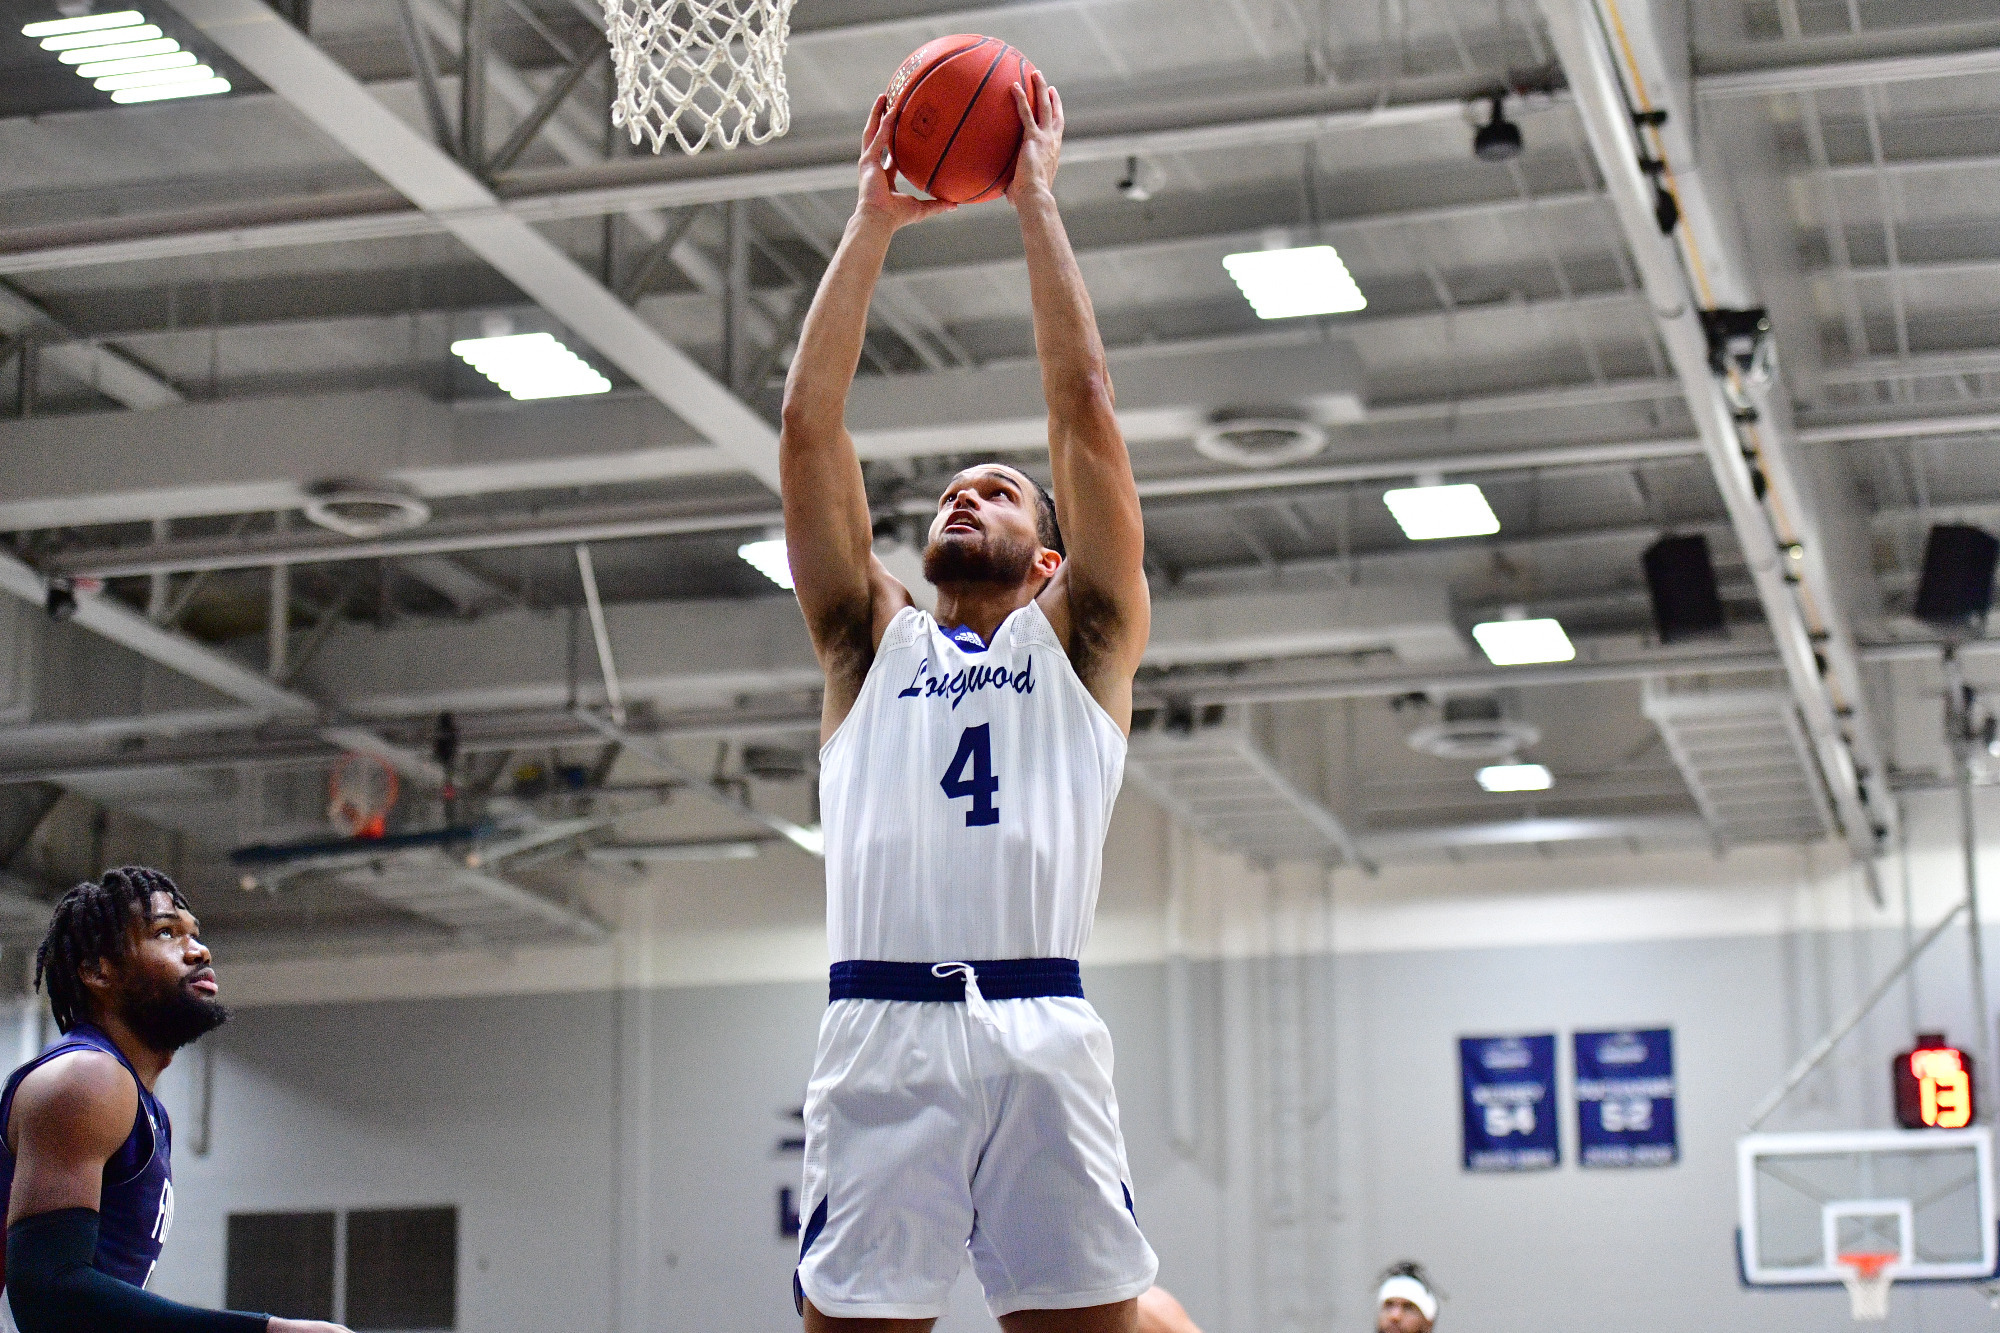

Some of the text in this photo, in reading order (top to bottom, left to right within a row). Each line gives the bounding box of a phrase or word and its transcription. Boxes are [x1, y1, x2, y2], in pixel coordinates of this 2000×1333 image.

[898, 654, 1036, 711] Longwod
[940, 722, 999, 827] 4
[1919, 1069, 1971, 1128] 13
